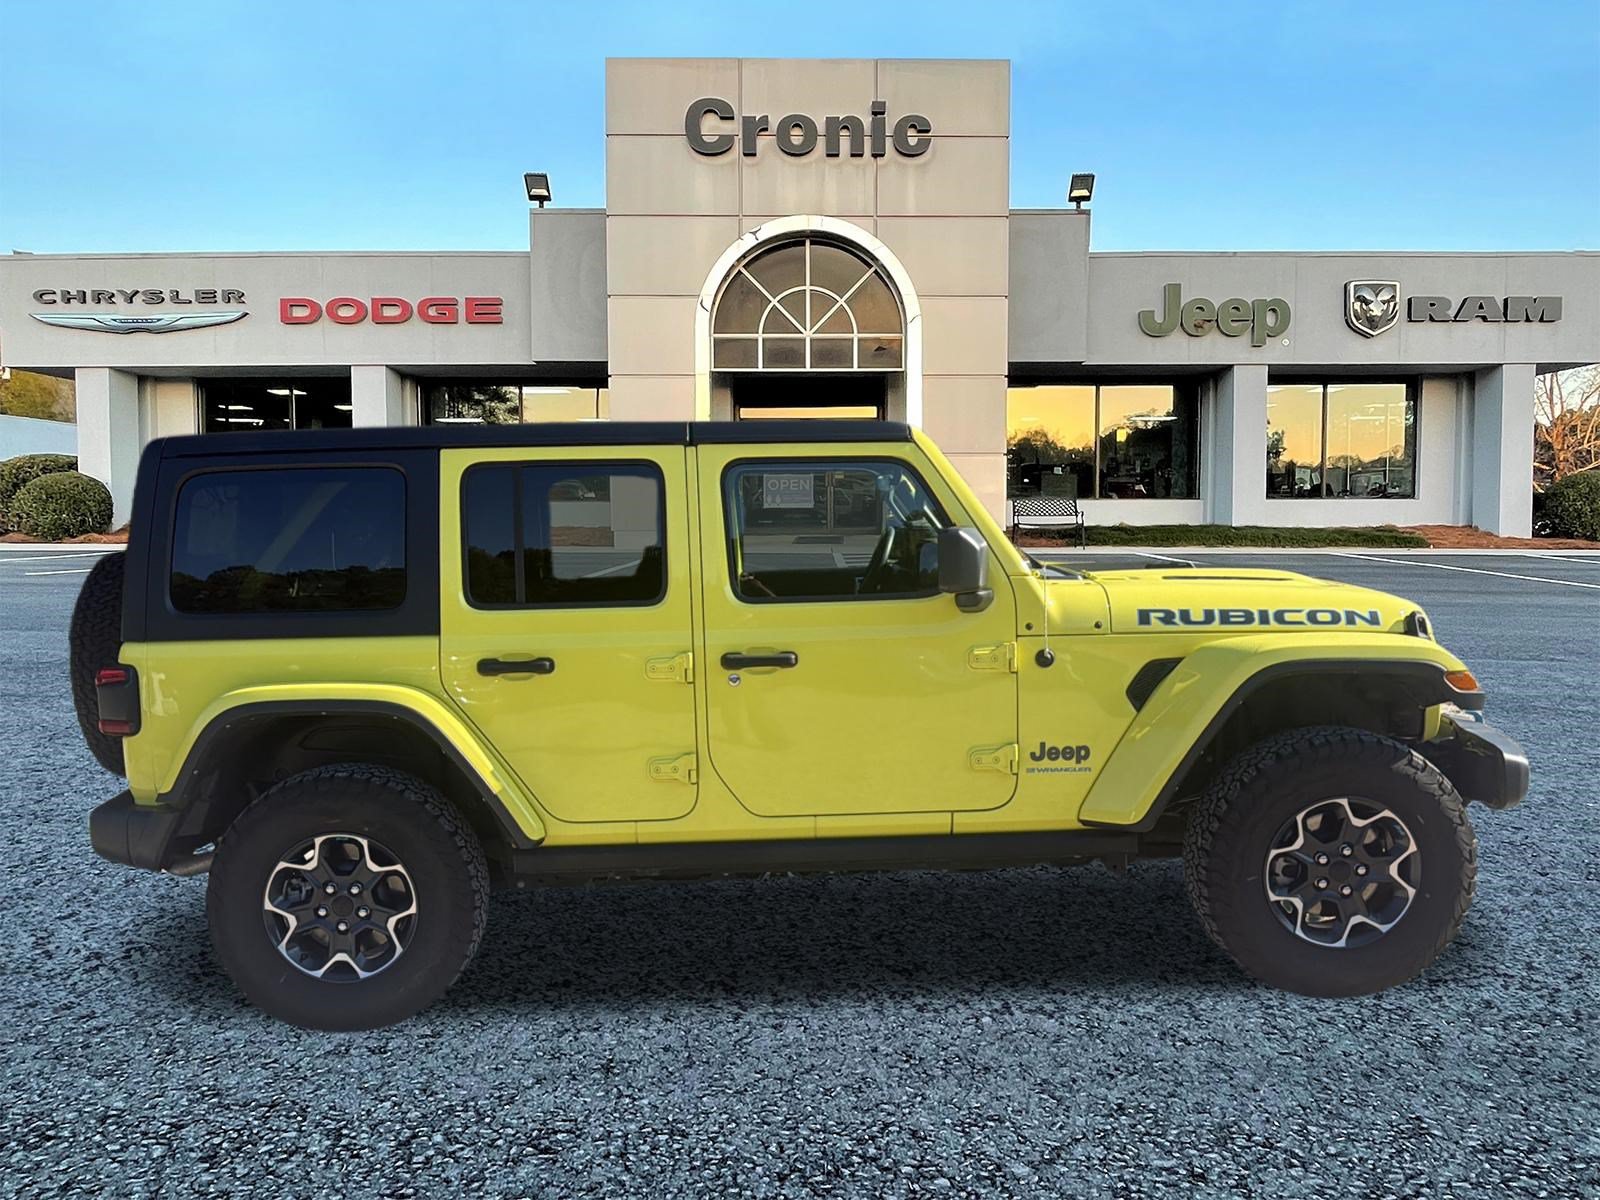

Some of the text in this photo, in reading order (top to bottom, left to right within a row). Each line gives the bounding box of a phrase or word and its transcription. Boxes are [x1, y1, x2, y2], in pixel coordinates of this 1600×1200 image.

[684, 97, 932, 157] Cronic
[31, 288, 247, 304] CHRYSLER
[279, 297, 504, 324] DODGE
[1138, 283, 1291, 347] Jeep
[1407, 296, 1563, 322] RAM
[767, 479, 810, 490] OPEN
[1137, 608, 1381, 627] RUBICON
[1029, 741, 1090, 765] Jeep
